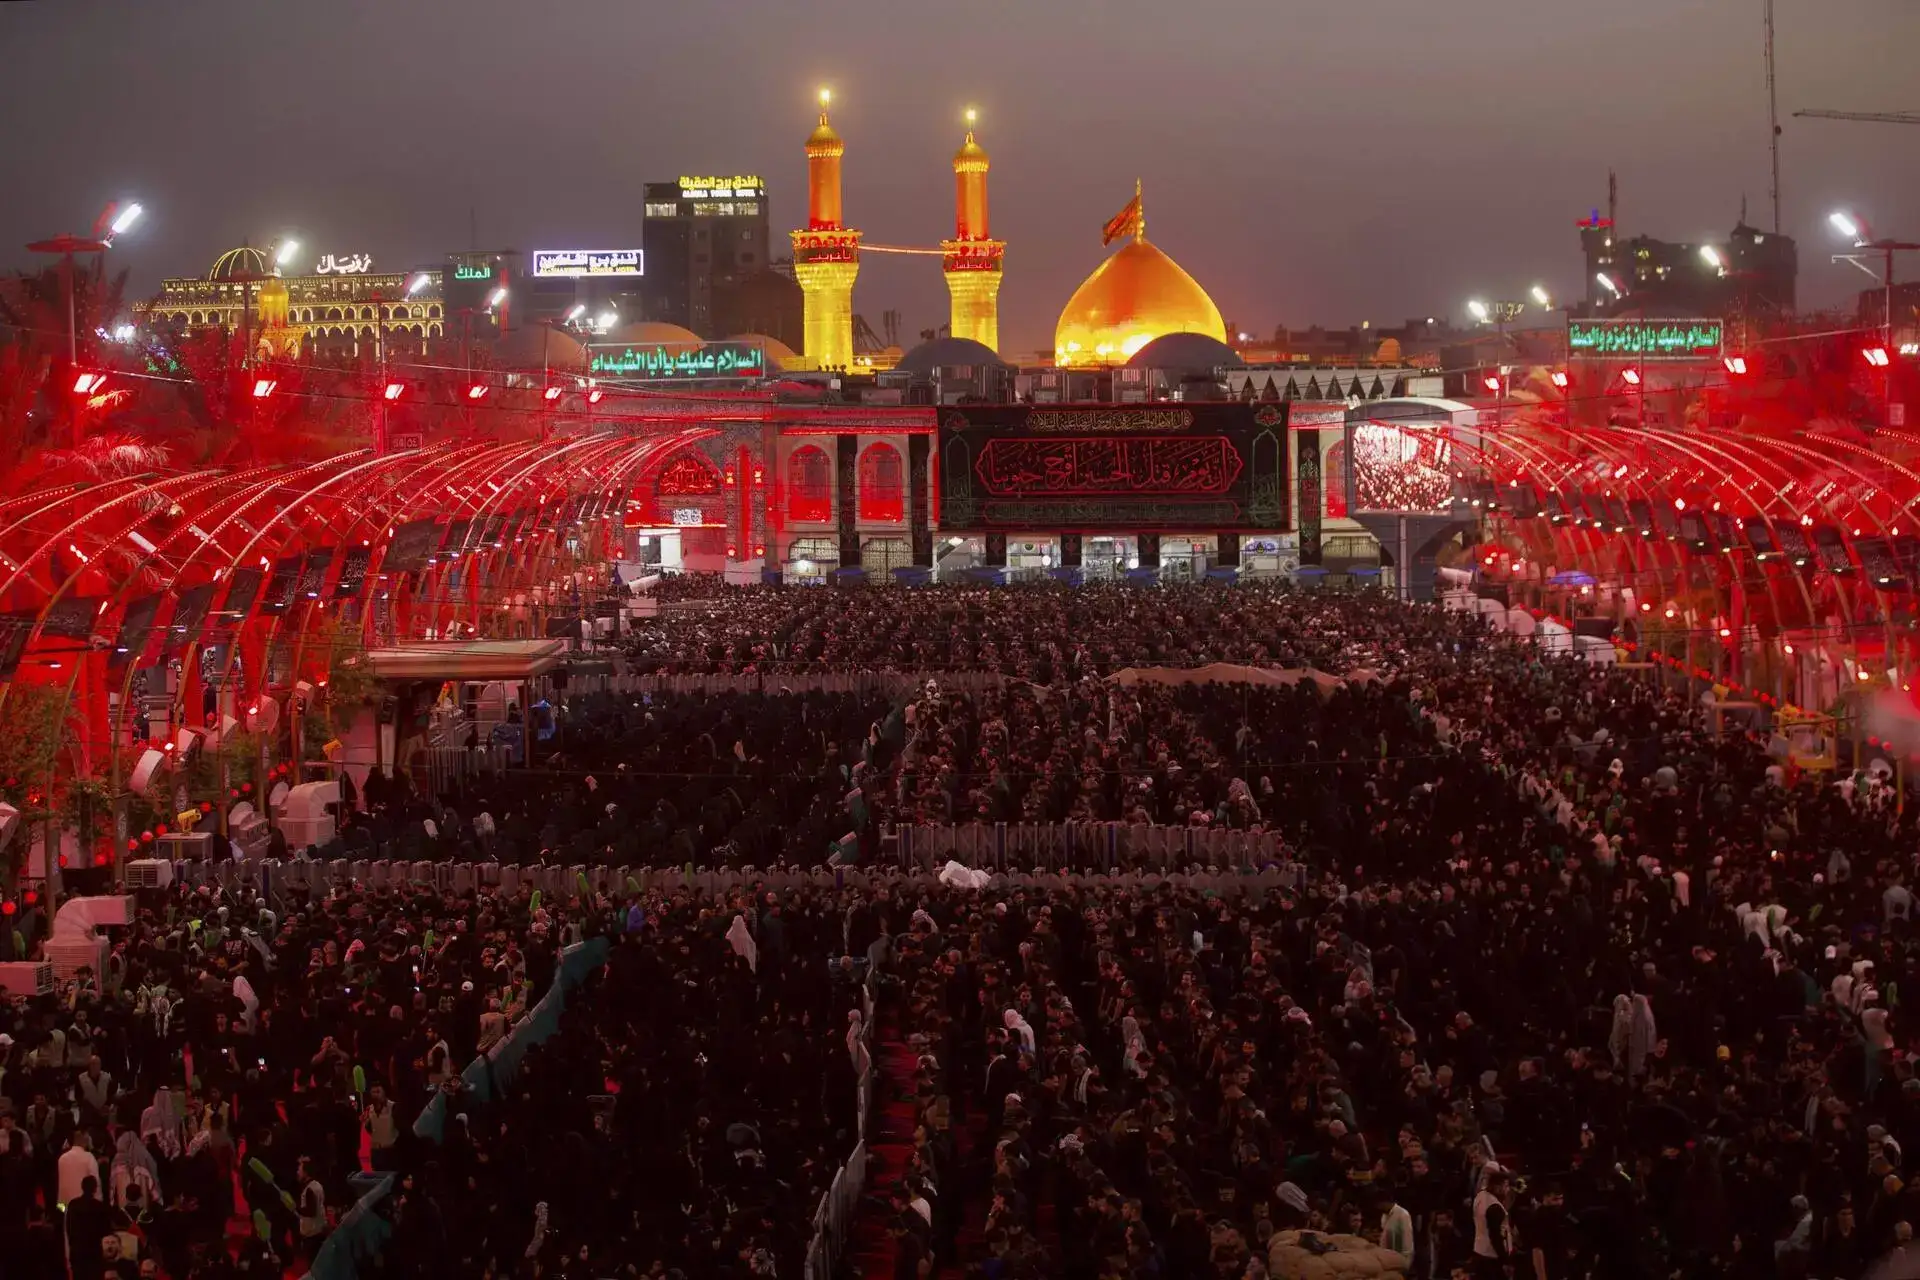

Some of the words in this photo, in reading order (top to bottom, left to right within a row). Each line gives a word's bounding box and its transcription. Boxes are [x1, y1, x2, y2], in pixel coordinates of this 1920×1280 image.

[716, 178, 732, 190] برج
[732, 176, 758, 189] فندق
[454, 264, 491, 280] الملك
[1657, 326, 1685, 352] عليك
[1686, 326, 1719, 351] السلام
[591, 348, 646, 375] الشهداء
[675, 350, 715, 375] عليك
[717, 349, 762, 374] السلام
